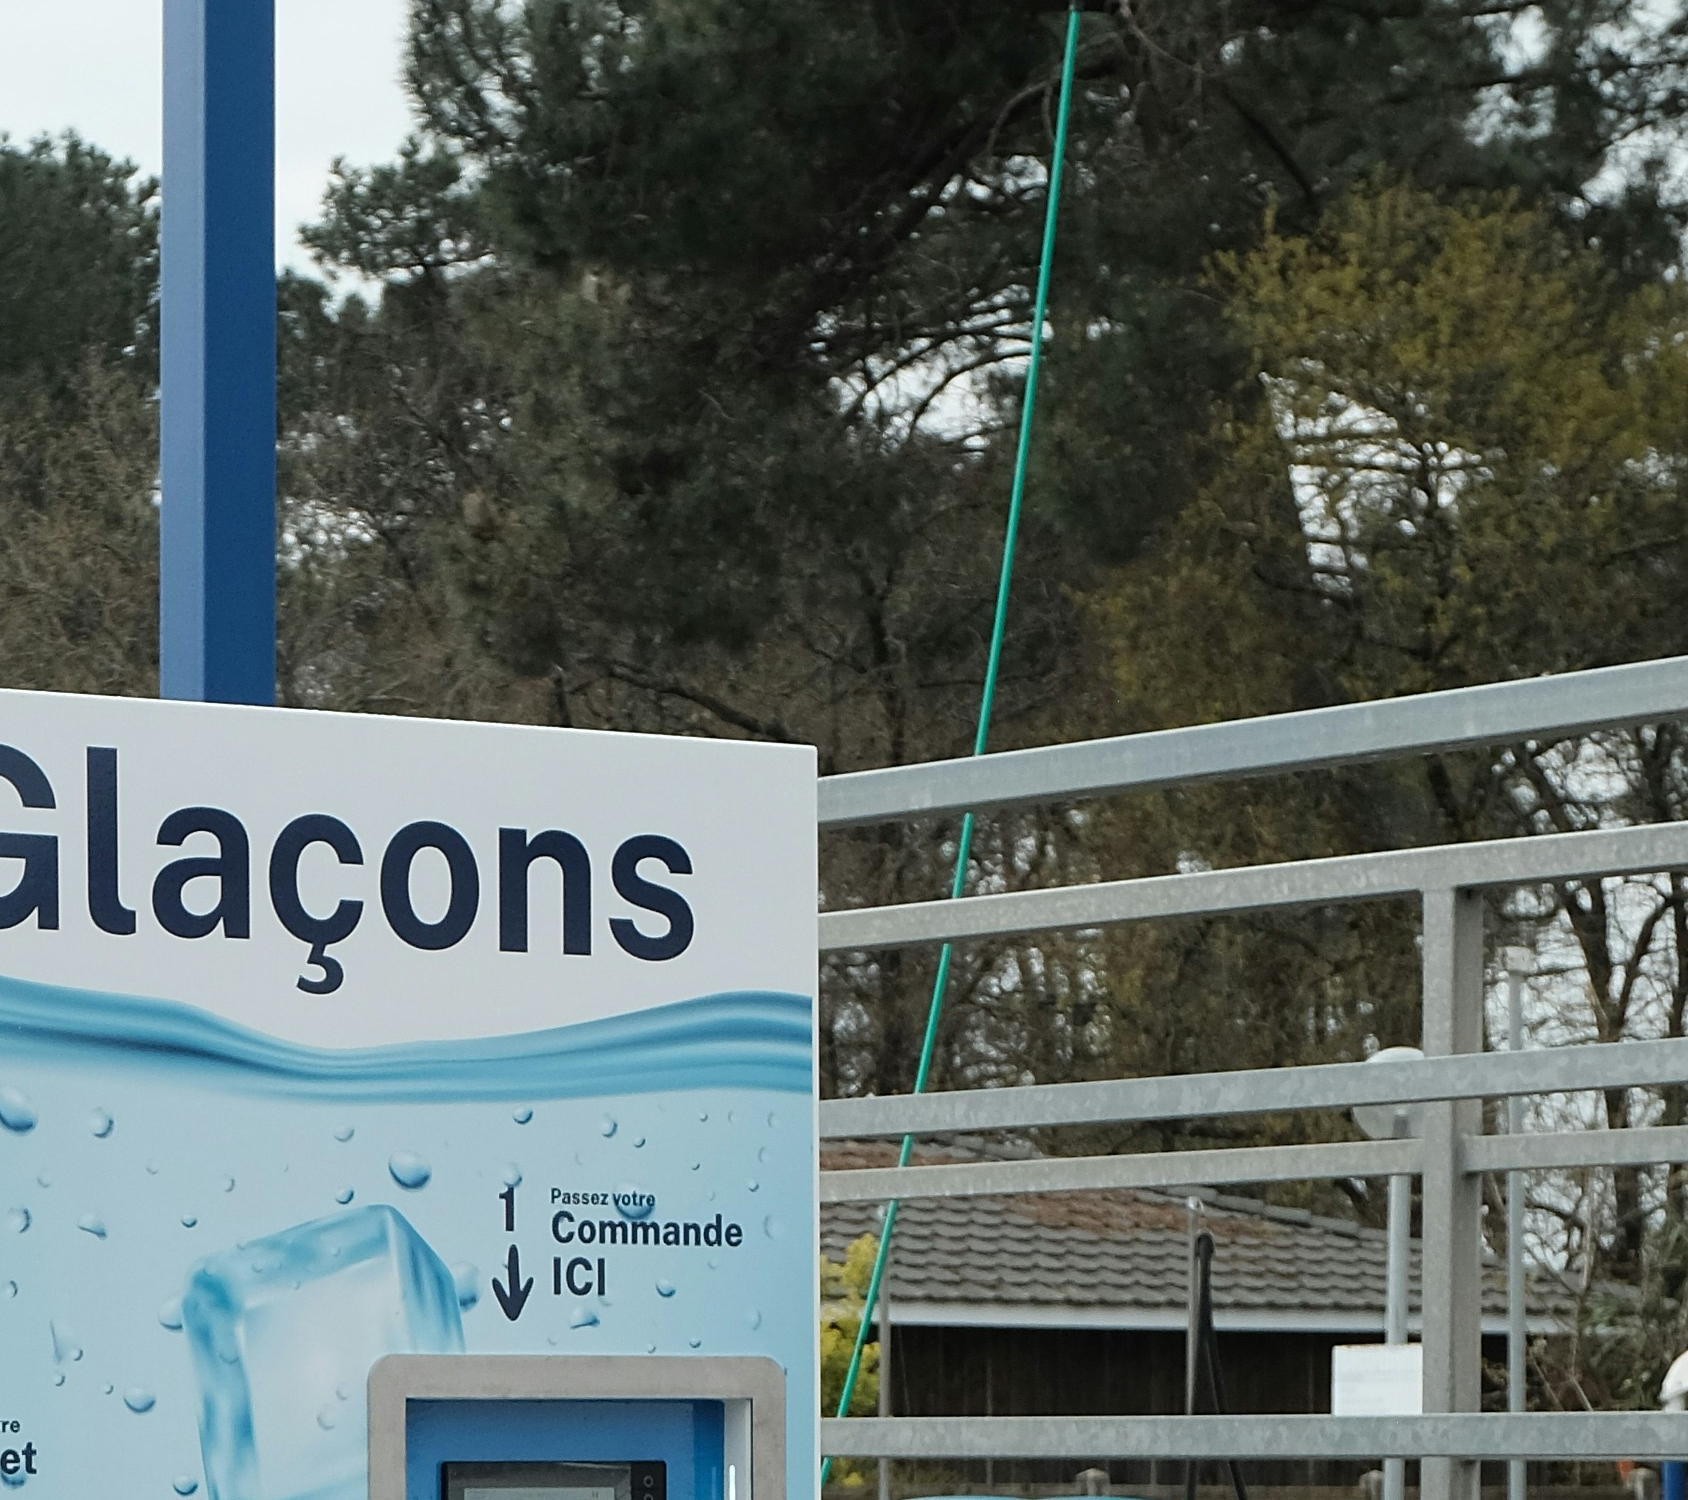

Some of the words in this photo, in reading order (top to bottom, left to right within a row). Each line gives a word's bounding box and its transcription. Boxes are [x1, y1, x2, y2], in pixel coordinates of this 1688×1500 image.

[498, 1186, 515, 1232] 1
[550, 1187, 609, 1206] Passez
[612, 1190, 656, 1207] votre
[551, 1210, 743, 1247] Commande
[553, 1256, 606, 1296] ICI
